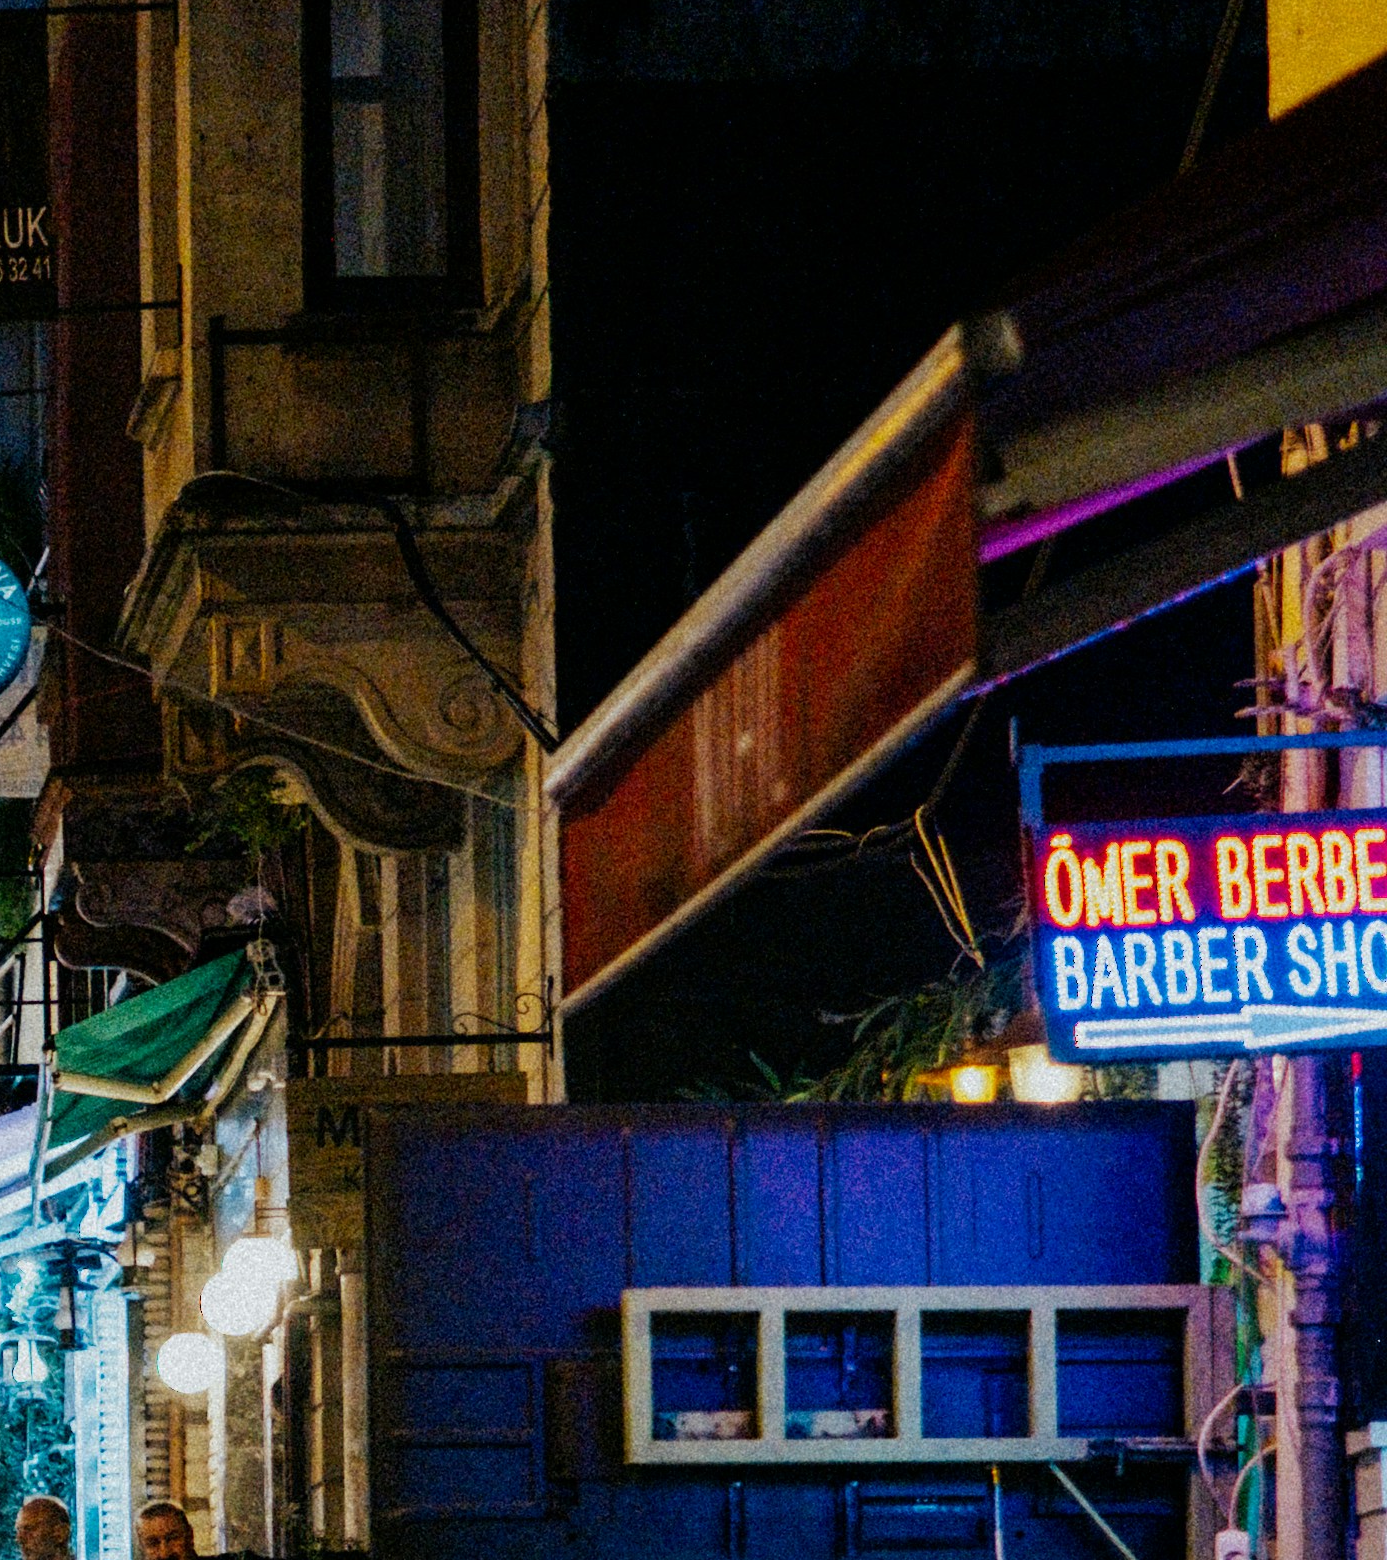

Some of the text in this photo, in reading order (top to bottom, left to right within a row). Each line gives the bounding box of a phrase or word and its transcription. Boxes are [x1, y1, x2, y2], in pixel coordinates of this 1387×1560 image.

[9, 256, 28, 282] 32
[32, 254, 52, 281] 41
[1044, 827, 1387, 929] ÖMER BERBE
[1052, 926, 1270, 1013] BARBER
